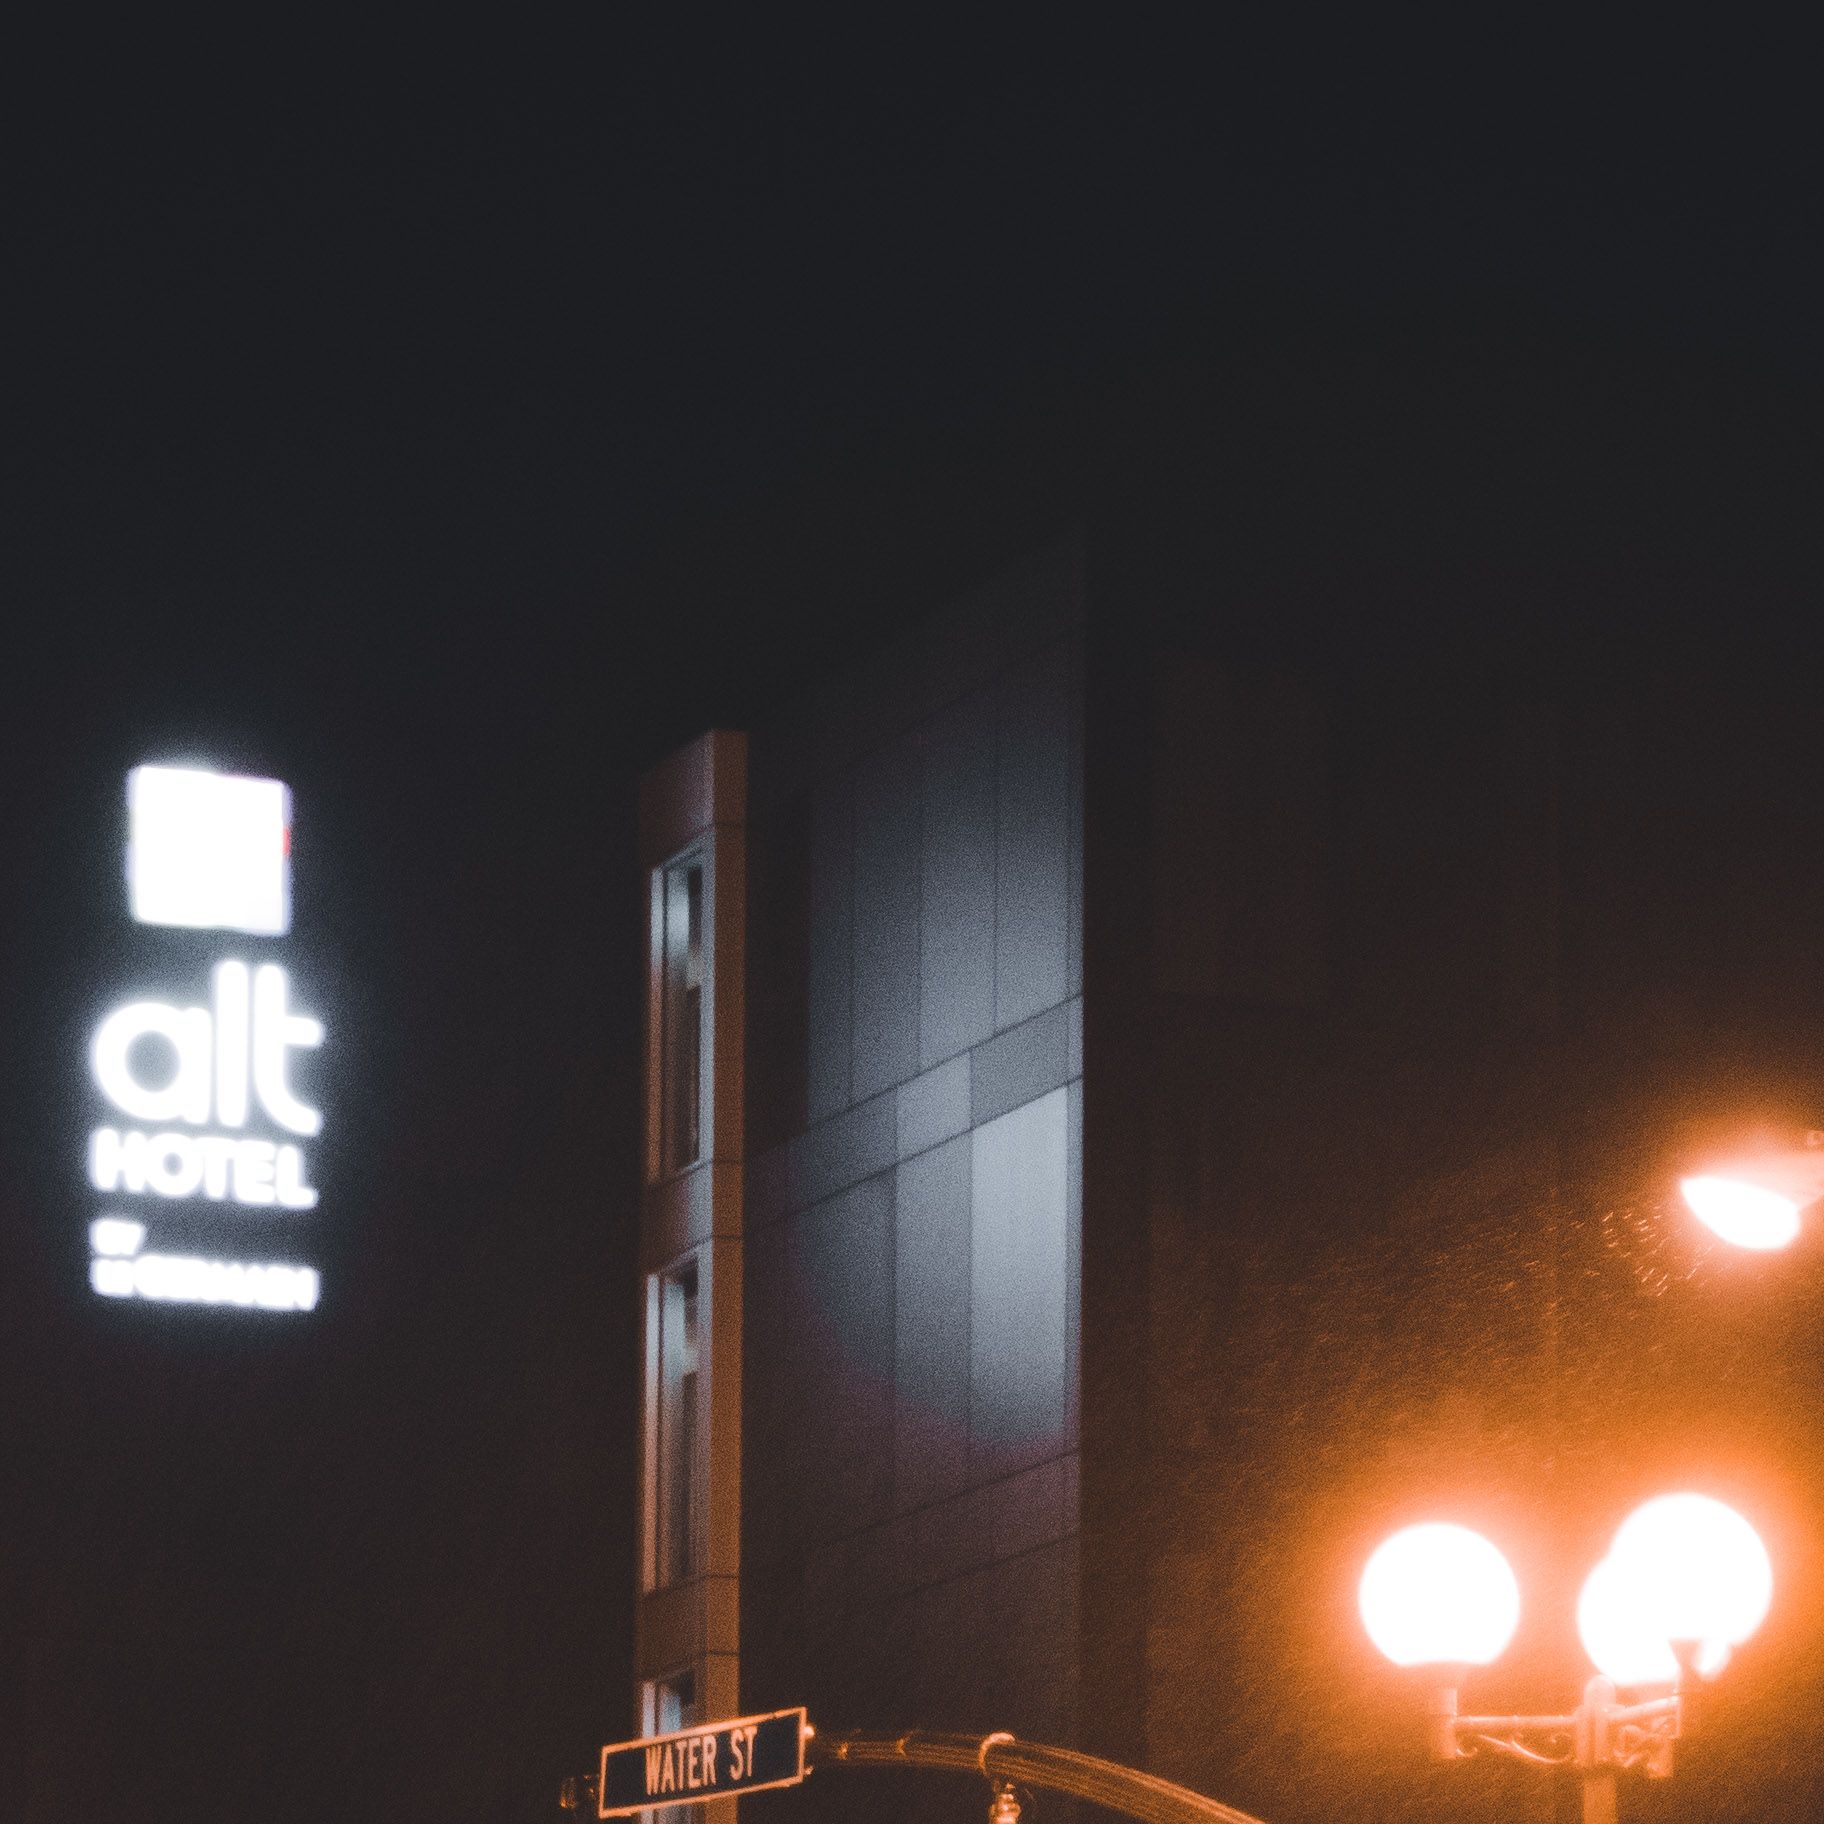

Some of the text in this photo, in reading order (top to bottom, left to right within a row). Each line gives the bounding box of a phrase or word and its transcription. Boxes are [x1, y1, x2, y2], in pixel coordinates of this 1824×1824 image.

[91, 957, 325, 1136] alt
[90, 1126, 318, 1210] HOTEL
[645, 1723, 759, 1796] WATER ST
